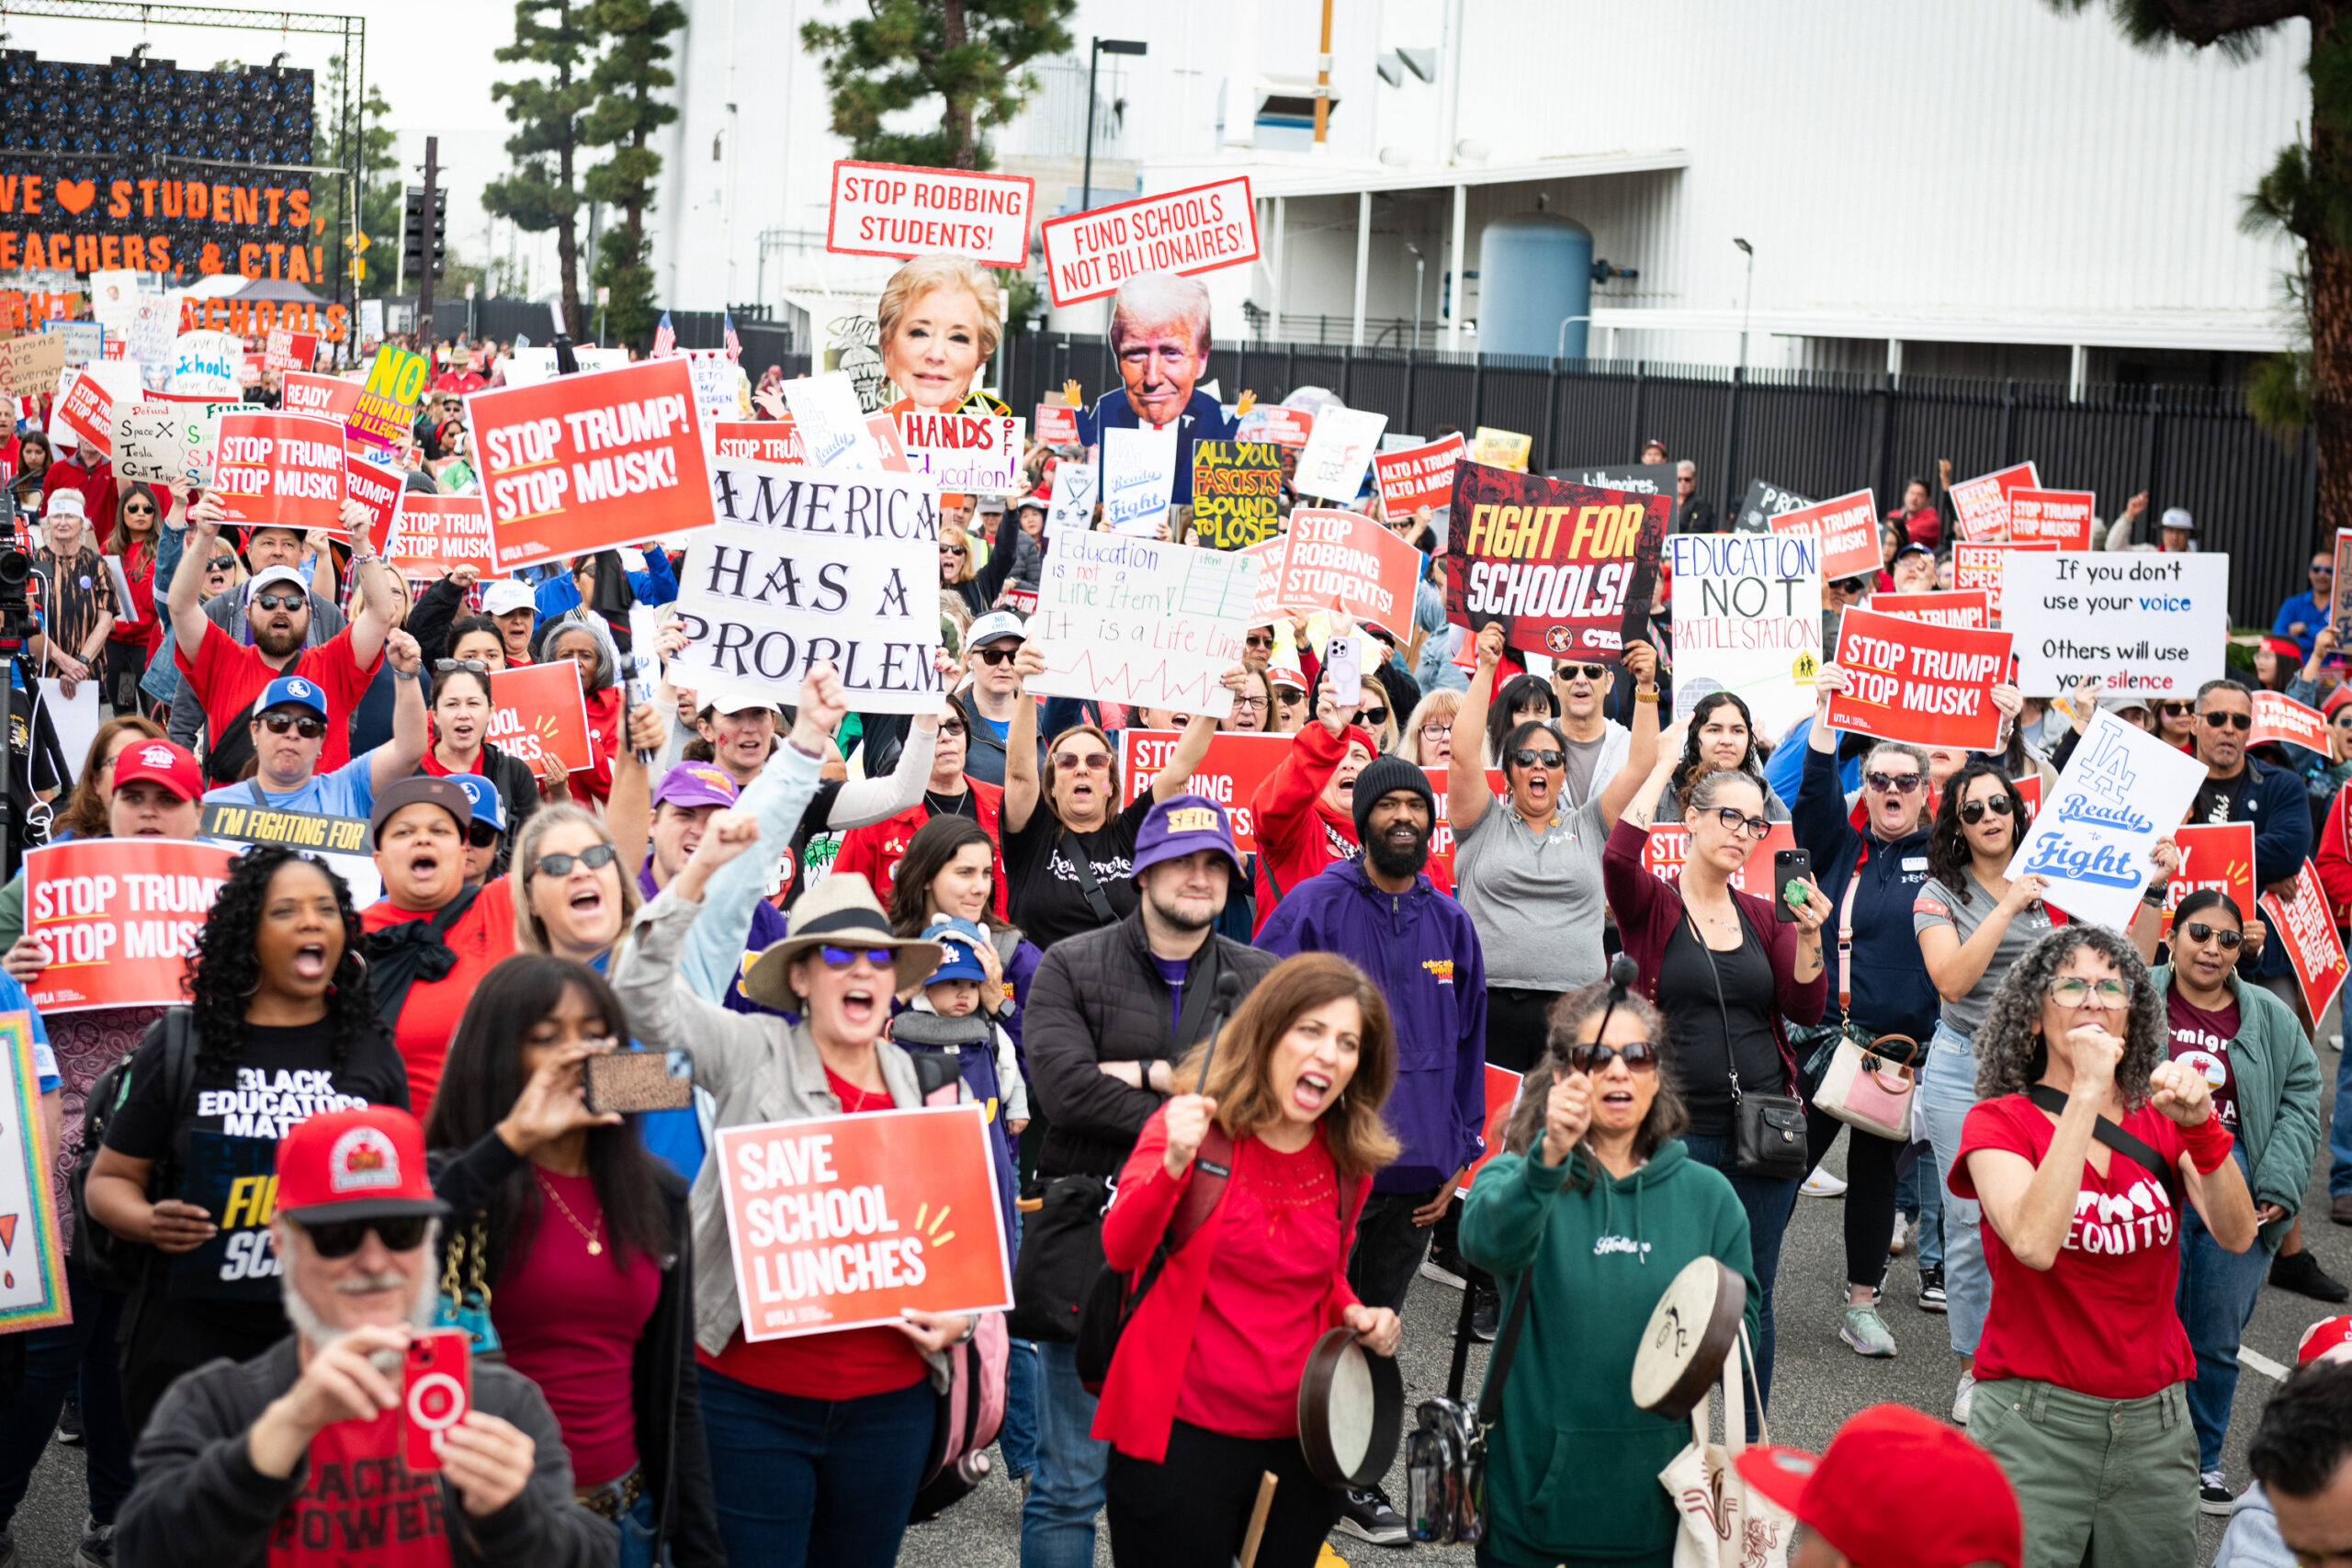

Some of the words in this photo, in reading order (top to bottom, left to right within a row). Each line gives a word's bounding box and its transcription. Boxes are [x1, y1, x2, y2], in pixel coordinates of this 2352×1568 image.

[108, 179, 325, 235] STUDENTS,
[844, 177, 907, 205] STOP
[914, 183, 1022, 215] ROBBING
[860, 215, 993, 250] STUDENTS!
[1074, 218, 1127, 256] FUND
[1134, 194, 1224, 241] SCHOOLS
[0, 231, 183, 280] EACHERS,
[198, 243, 226, 274] &
[240, 243, 324, 283] CTA!
[1062, 256, 1103, 293] NOT
[1108, 221, 1246, 281] BILLIONAIRES!
[175, 354, 231, 378] Schools
[366, 345, 426, 405] NO
[67, 395, 91, 421] STOP
[75, 382, 100, 406] STOP
[132, 407, 169, 415] Defund
[287, 384, 333, 408] READY
[356, 395, 413, 426] HUMAN
[120, 420, 153, 438] Space
[349, 413, 360, 429] IS
[486, 417, 561, 470] STOP
[564, 394, 690, 453] TRUMP!
[907, 414, 993, 450] HANDS
[120, 443, 153, 457] Tesla
[222, 436, 273, 463] STOP
[277, 439, 344, 472] TRUMP!
[720, 438, 761, 458] STOP
[1195, 441, 1231, 467] ALL
[1235, 442, 1280, 467] YOU
[1381, 461, 1411, 482] ALTO
[1412, 459, 1422, 476] A
[1422, 446, 1465, 471] TRUMP!
[121, 462, 149, 478] Golf
[151, 466, 175, 483] Trip
[218, 468, 270, 494] STOP
[275, 470, 337, 501] MUSK!
[493, 468, 568, 521] STOP
[572, 446, 678, 503] MUSK!
[907, 453, 1015, 489] ducation!
[1194, 467, 1282, 497] FASCISTS
[347, 473, 395, 508] RUMP!
[715, 469, 937, 542] AMERICA
[1385, 481, 1415, 501] ALTO
[1416, 478, 1426, 494] A
[1955, 479, 2001, 504] DEFEND
[398, 512, 440, 533] STOP
[443, 513, 488, 535] TRUM
[1110, 492, 1166, 525] Fight
[1194, 497, 1278, 517] BOUND
[1821, 504, 1872, 534] TRUMP!
[2013, 500, 2041, 517] STOP
[2042, 502, 2089, 521] TRUMP!
[1193, 519, 1215, 536] TO
[1215, 514, 1278, 548] LOSE
[1296, 516, 1352, 541] STOP
[1466, 504, 1569, 558] FIGHT
[1568, 503, 1645, 559] FOR
[1825, 528, 1869, 556] MUSK!
[2012, 518, 2040, 535] STOP
[2040, 520, 2080, 537] MUSK!
[396, 536, 438, 557] STOP
[442, 537, 491, 558] MUSK
[1059, 530, 1159, 571] Education
[1199, 554, 1222, 565] item
[1292, 542, 1380, 581] ROBBING
[1674, 536, 1815, 579] EDUCATION
[707, 545, 850, 613] HAS
[875, 568, 910, 617] A
[1052, 564, 1065, 579] is
[1077, 563, 1101, 581] not
[1115, 570, 1125, 584] a
[2055, 558, 2079, 581] If
[2087, 566, 2122, 585] you
[2129, 559, 2182, 581] don't
[1058, 581, 1098, 606] Line
[1286, 569, 1393, 615] STUDENTS!
[1467, 561, 1634, 617] SCHOOLS!
[1702, 577, 1804, 617] NOT
[2043, 595, 2079, 611] use
[2086, 595, 2132, 615] your
[2140, 593, 2191, 611] voice
[1042, 611, 1073, 640] It
[1099, 619, 1120, 641] is
[1132, 625, 1144, 642] a
[1154, 620, 1197, 652] Life
[1205, 625, 1246, 661] Line
[1582, 628, 1623, 650] CTA
[1674, 616, 1821, 650] BATTLESTATION
[2042, 639, 2110, 660] Others
[2117, 640, 2149, 660] will
[2154, 646, 2189, 661] use
[669, 611, 945, 692] PROBLEM
[1845, 634, 1905, 671] STOP
[1911, 647, 2000, 682] TRUMP!
[1844, 669, 1899, 705] STOP
[1902, 682, 1981, 716] MUSK!
[2056, 673, 2101, 692] your
[2108, 671, 2174, 690] silence
[1833, 713, 1850, 724] UTLA
[2256, 700, 2321, 730] TRUMP!
[2257, 714, 2313, 738] MUSK!
[213, 807, 246, 836] I'M
[245, 810, 328, 846] FIGHTING
[326, 820, 366, 851] FOR
[1168, 807, 1218, 833] SEIU
[2058, 793, 2153, 834] Ready
[2024, 831, 2143, 889] Fight
[34, 874, 116, 919] STOP
[36, 921, 116, 965] STOP
[124, 920, 198, 958] MUS
[2322, 929, 2337, 969] LOS
[32, 992, 54, 1005] UTLA
[737, 1134, 838, 1191] SAVE
[745, 1185, 899, 1247] SCHOOL
[2063, 1212, 2174, 1256] EQUITY
[753, 1236, 926, 1303] LUNCHES
[764, 1309, 796, 1327] UTLA
